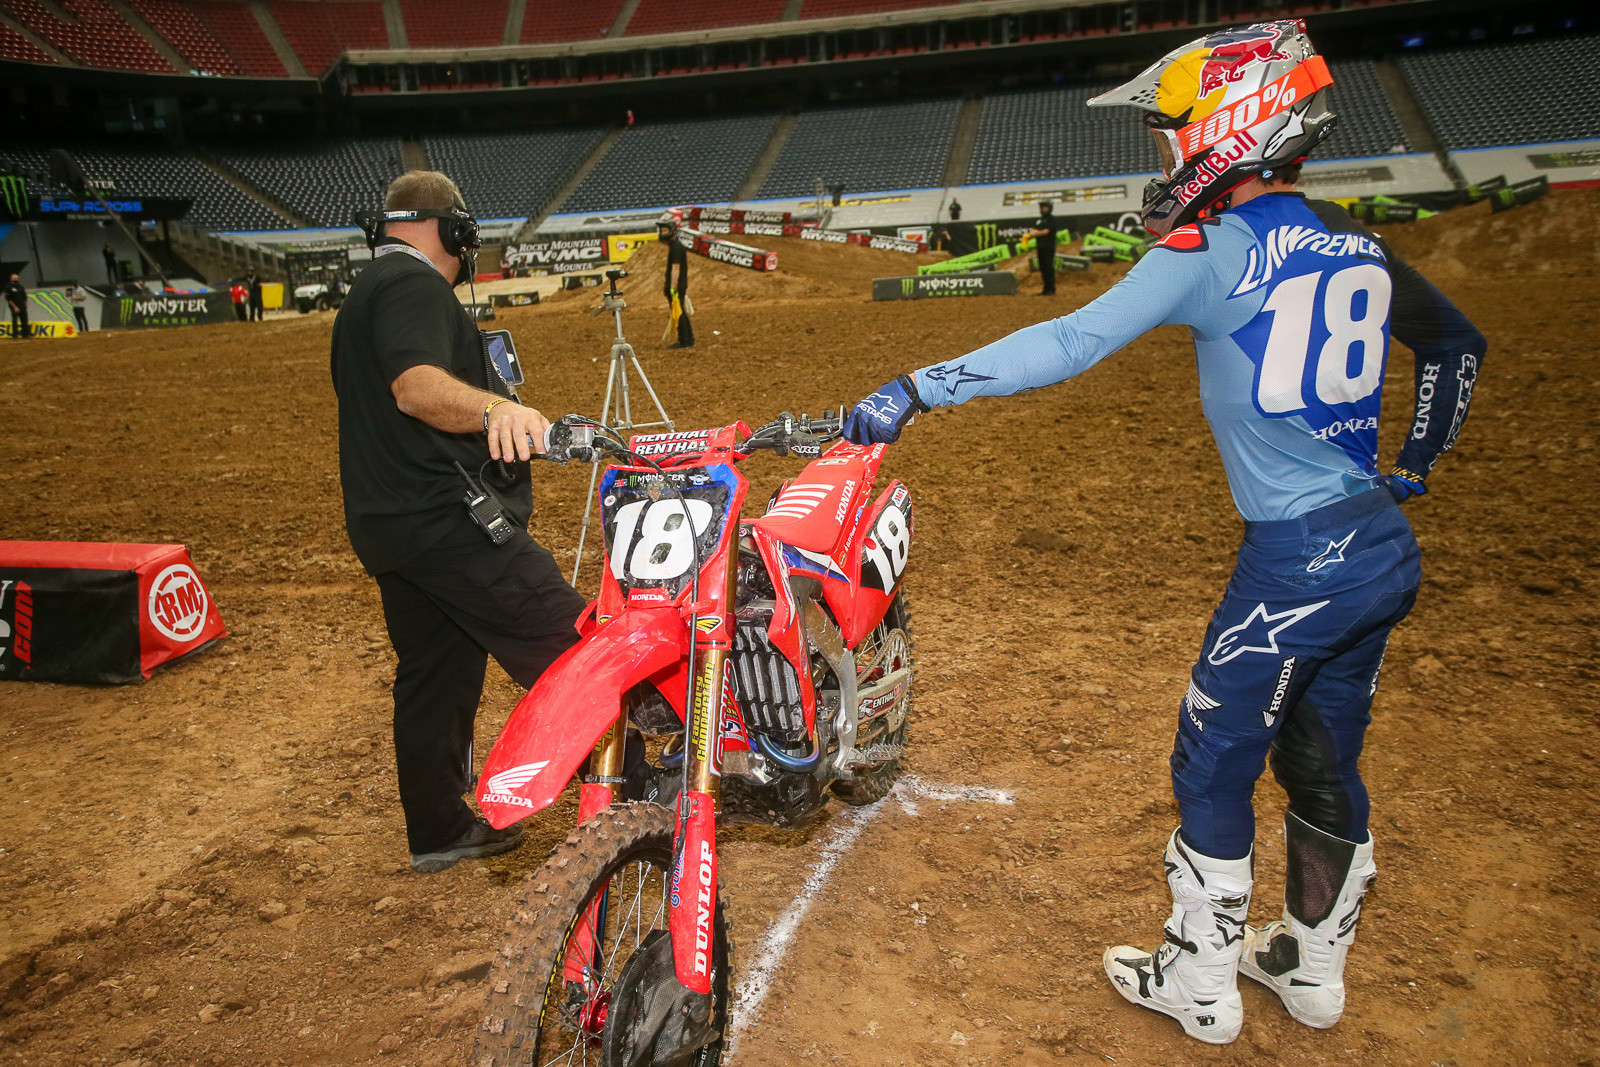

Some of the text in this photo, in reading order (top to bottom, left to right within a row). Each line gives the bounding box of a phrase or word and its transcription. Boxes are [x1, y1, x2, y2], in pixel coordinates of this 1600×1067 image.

[1185, 74, 1297, 154] 100%
[1173, 130, 1259, 207] Red Bull
[40, 201, 142, 212] SUPRCOSS
[519, 238, 601, 252] ROCKY MOUNTAIN
[997, 228, 1034, 238] MONST
[1232, 225, 1386, 297] LAWRENCE
[918, 277, 984, 291] MONSTER
[134, 297, 209, 315] MONSTER
[0, 323, 55, 337] SUUKI
[1257, 264, 1393, 414] 18
[857, 402, 893, 426] ASTARS
[1411, 362, 1442, 442] HOND
[634, 439, 711, 455] RENTHAL
[635, 429, 711, 444] RENTHAL
[637, 472, 686, 483] MONSER
[834, 479, 856, 526] HONDA
[609, 498, 713, 580] 18
[865, 505, 910, 596] 18
[160, 582, 201, 625] RM
[631, 593, 665, 601] HONDA
[1269, 656, 1297, 713] HONDA
[692, 675, 704, 745] Factory
[696, 661, 716, 762] Connection
[481, 793, 535, 809] HONDA
[694, 839, 714, 978] DUNLOP
